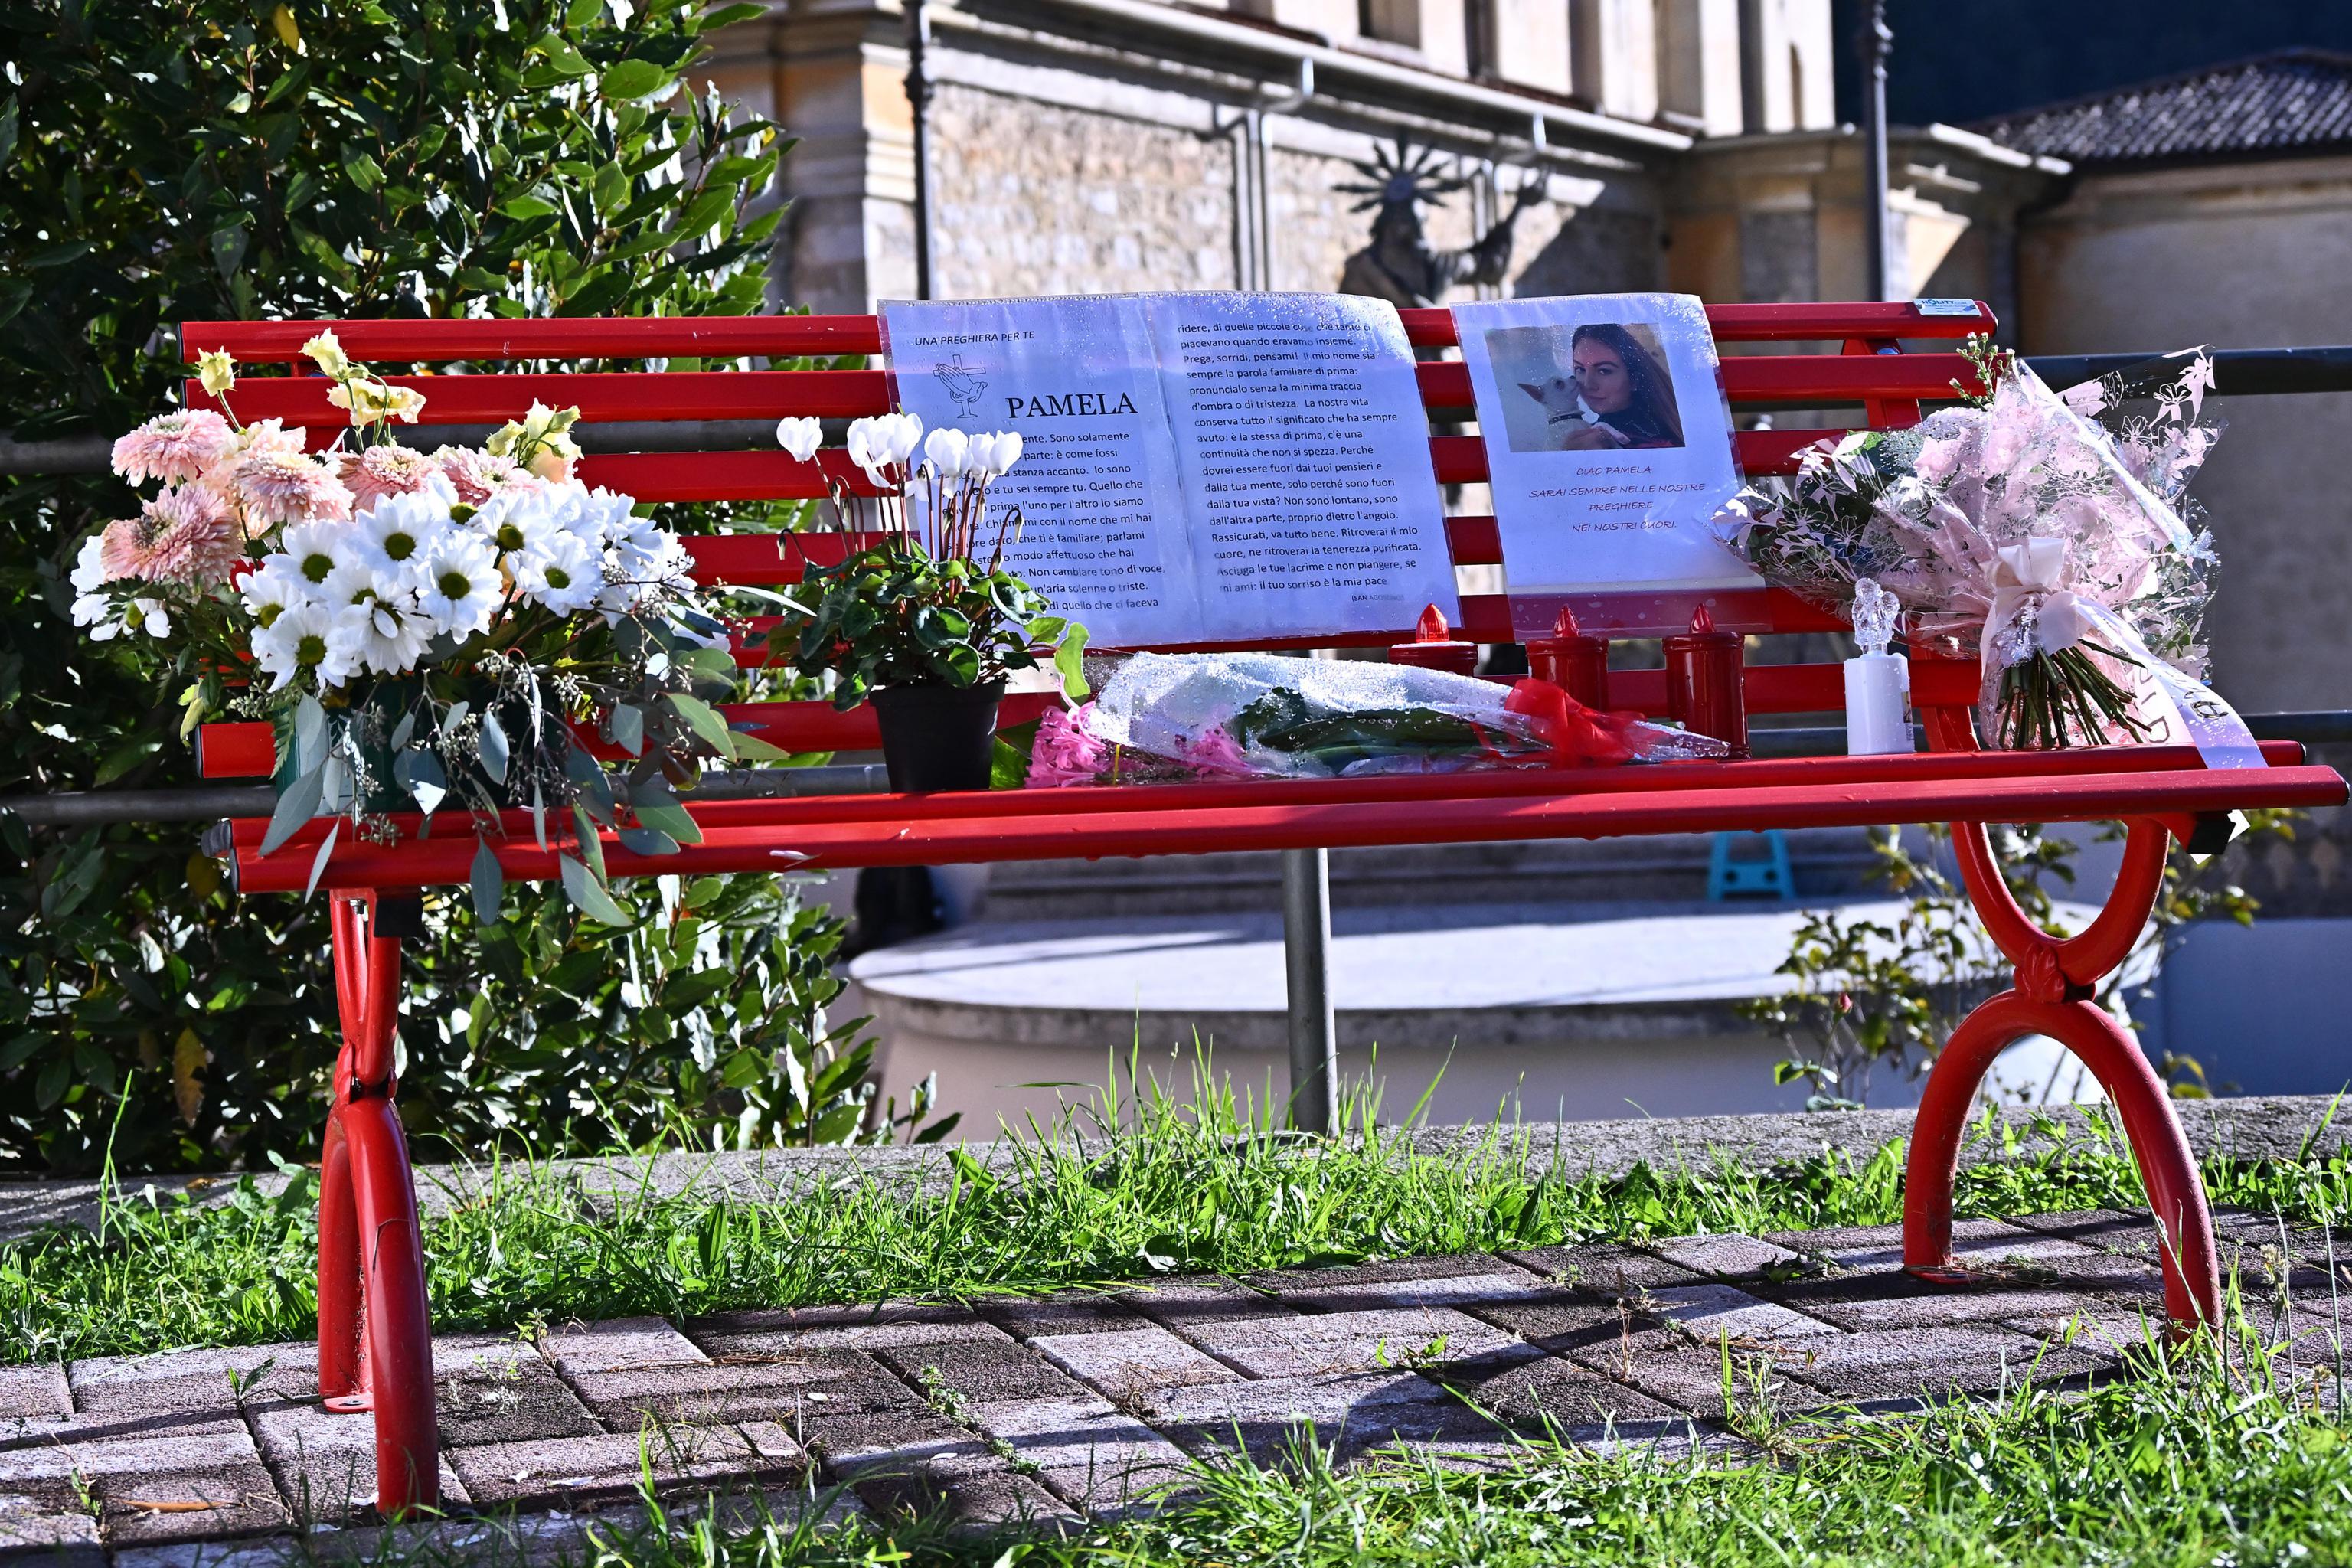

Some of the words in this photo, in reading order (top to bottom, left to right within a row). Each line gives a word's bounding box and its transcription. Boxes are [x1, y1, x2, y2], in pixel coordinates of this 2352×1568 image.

[1178, 324, 1210, 333] ridere,
[1212, 322, 1222, 331] di
[1224, 322, 1254, 332] quelle
[1256, 323, 1290, 332] piccole
[914, 337, 938, 345] UNA
[940, 333, 998, 344] PREGHIERA
[1001, 332, 1019, 341] PER
[1022, 331, 1034, 339] TE
[1181, 339, 1230, 349] piacevano
[1233, 337, 1269, 347] quando
[1183, 355, 1214, 364] Prega,
[1217, 352, 1250, 362] sorridi,
[1253, 351, 1298, 362] pensami!
[1362, 351, 1376, 360] sia
[1187, 371, 1223, 380] sempre
[1236, 368, 1267, 378] parola
[1270, 367, 1312, 376] familiare
[1315, 366, 1325, 375] di
[1327, 367, 1357, 376] prima:
[1189, 384, 1247, 396] pronuncialo
[1291, 383, 1327, 391] minima
[1329, 381, 1361, 390] traccia
[1004, 392, 1138, 419] PAMELA
[1191, 401, 1233, 410] d'ombra
[1256, 400, 1298, 408] tristezza.
[1304, 399, 1315, 407] La
[1351, 397, 1368, 406] vita
[1240, 416, 1265, 425] tutto
[1276, 414, 1325, 425] significato
[1327, 413, 1344, 423] che
[1347, 413, 1359, 422] ha
[1050, 433, 1075, 443] Sono
[1077, 433, 1129, 441] solamente
[1294, 431, 1325, 441] prima,
[1328, 430, 1341, 439] c'è
[1024, 449, 1054, 461] parte:
[1095, 448, 1117, 457] fossi
[1200, 449, 1249, 459] continuità
[1252, 448, 1269, 457] che
[1303, 449, 1338, 457] spezza.
[1340, 445, 1373, 455] Perché
[1013, 468, 1044, 476] stanza
[1047, 467, 1088, 476] accanto.
[1202, 466, 1233, 475] dovrei
[1269, 463, 1293, 472] fuori
[1295, 463, 1310, 472] dai
[1312, 462, 1332, 472] tuoi
[1334, 462, 1373, 472] pensieri
[1576, 467, 1602, 475] CIAO
[1606, 466, 1651, 474] PAMELA
[1002, 485, 1013, 494] tu
[1016, 484, 1030, 493] sei
[1033, 485, 1069, 494] sempre
[1089, 480, 1122, 491] Quello
[1125, 479, 1142, 488] che
[1204, 482, 1228, 492] dalla
[1250, 481, 1285, 489] mente,
[1287, 479, 1308, 488] solo
[1310, 479, 1342, 489] perché
[1371, 477, 1394, 486] fuori
[1528, 488, 1566, 498] SARAI
[1568, 485, 1616, 495] SEMPRE
[1619, 485, 1655, 493] NELLE
[1658, 483, 1705, 492] NOSTRE
[990, 502, 1021, 512] prima
[1022, 501, 1047, 509] l'uno
[1050, 502, 1066, 511] per
[1069, 499, 1098, 508] l'altro
[1101, 498, 1111, 507] lo
[1113, 498, 1143, 507] siamo
[1207, 499, 1230, 508] dalla
[1252, 495, 1280, 506] vista?
[1283, 496, 1303, 505] Non
[1331, 495, 1372, 505] lontano,
[1589, 501, 1652, 511] PREGHIERE
[1068, 518, 1096, 526] nome
[1099, 515, 1117, 524] che
[1120, 514, 1133, 523] mi
[1135, 512, 1152, 522] hai
[1210, 515, 1253, 525] dall'altra
[1256, 514, 1285, 524] parte,
[1288, 513, 1323, 523] proprio
[1325, 511, 1355, 521] dietro
[1357, 511, 1398, 521] l'angolo.
[1572, 523, 1591, 532] NEI
[1593, 522, 1637, 531] NOSTRI
[1640, 521, 1676, 529] CUORI.
[1019, 534, 1037, 543] che
[1057, 533, 1103, 542] familiare;
[1106, 531, 1144, 543] parlami
[1211, 531, 1268, 542] Rassicurati,
[1310, 529, 1338, 538] bene.
[1341, 528, 1387, 537] Ritroverai
[1399, 526, 1418, 534] mio
[1013, 550, 1043, 560] modo
[1046, 550, 1095, 559] affettuoso
[1098, 550, 1116, 559] che
[1118, 547, 1134, 557] hai
[1214, 550, 1246, 559] cuore,
[1264, 546, 1308, 555] ritroverai
[1322, 545, 1370, 554] tenerezza
[1373, 543, 1421, 553] purificata.
[1028, 567, 1050, 577] Non
[1052, 567, 1096, 576] cambiare
[1099, 567, 1124, 576] tono
[1126, 564, 1136, 573] di
[1287, 563, 1324, 572] lacrime
[1357, 560, 1402, 570] piangere,
[1118, 582, 1148, 591] triste.
[1234, 582, 1256, 592] ami:
[1287, 580, 1321, 589] sorriso
[1343, 577, 1361, 586] mia
[1364, 578, 1387, 586] pace
[1049, 601, 1060, 610] di
[1061, 600, 1092, 611] quello
[1094, 600, 1112, 609] che
[1125, 599, 1158, 608] faceva
[1351, 594, 1367, 603] (SAN
